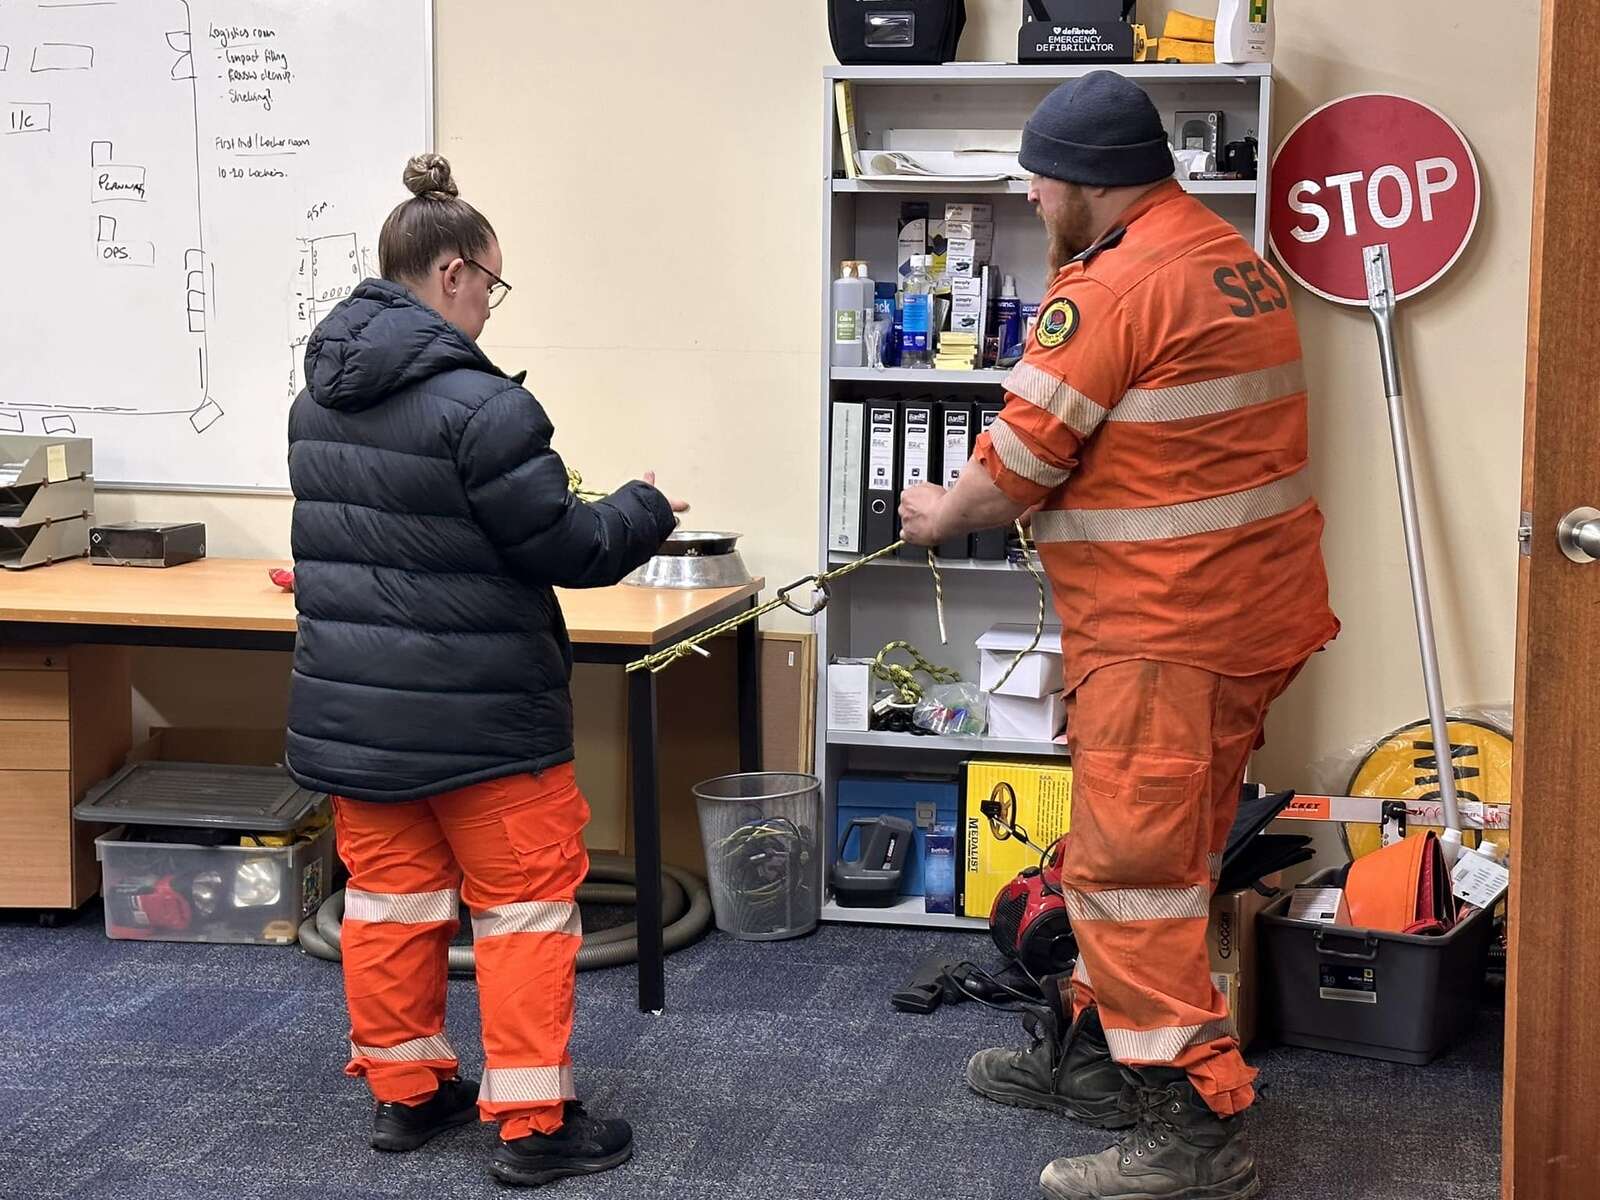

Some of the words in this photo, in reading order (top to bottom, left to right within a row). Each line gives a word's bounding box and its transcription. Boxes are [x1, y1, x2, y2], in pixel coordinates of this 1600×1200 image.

[1048, 35, 1102, 44] EMERGENCY
[1062, 27, 1097, 35] defibtech
[1036, 43, 1114, 52] DEFIBRILLATOR
[1288, 157, 1458, 243] STOP
[1213, 260, 1287, 318] SES
[968, 817, 979, 872] MEDALIST
